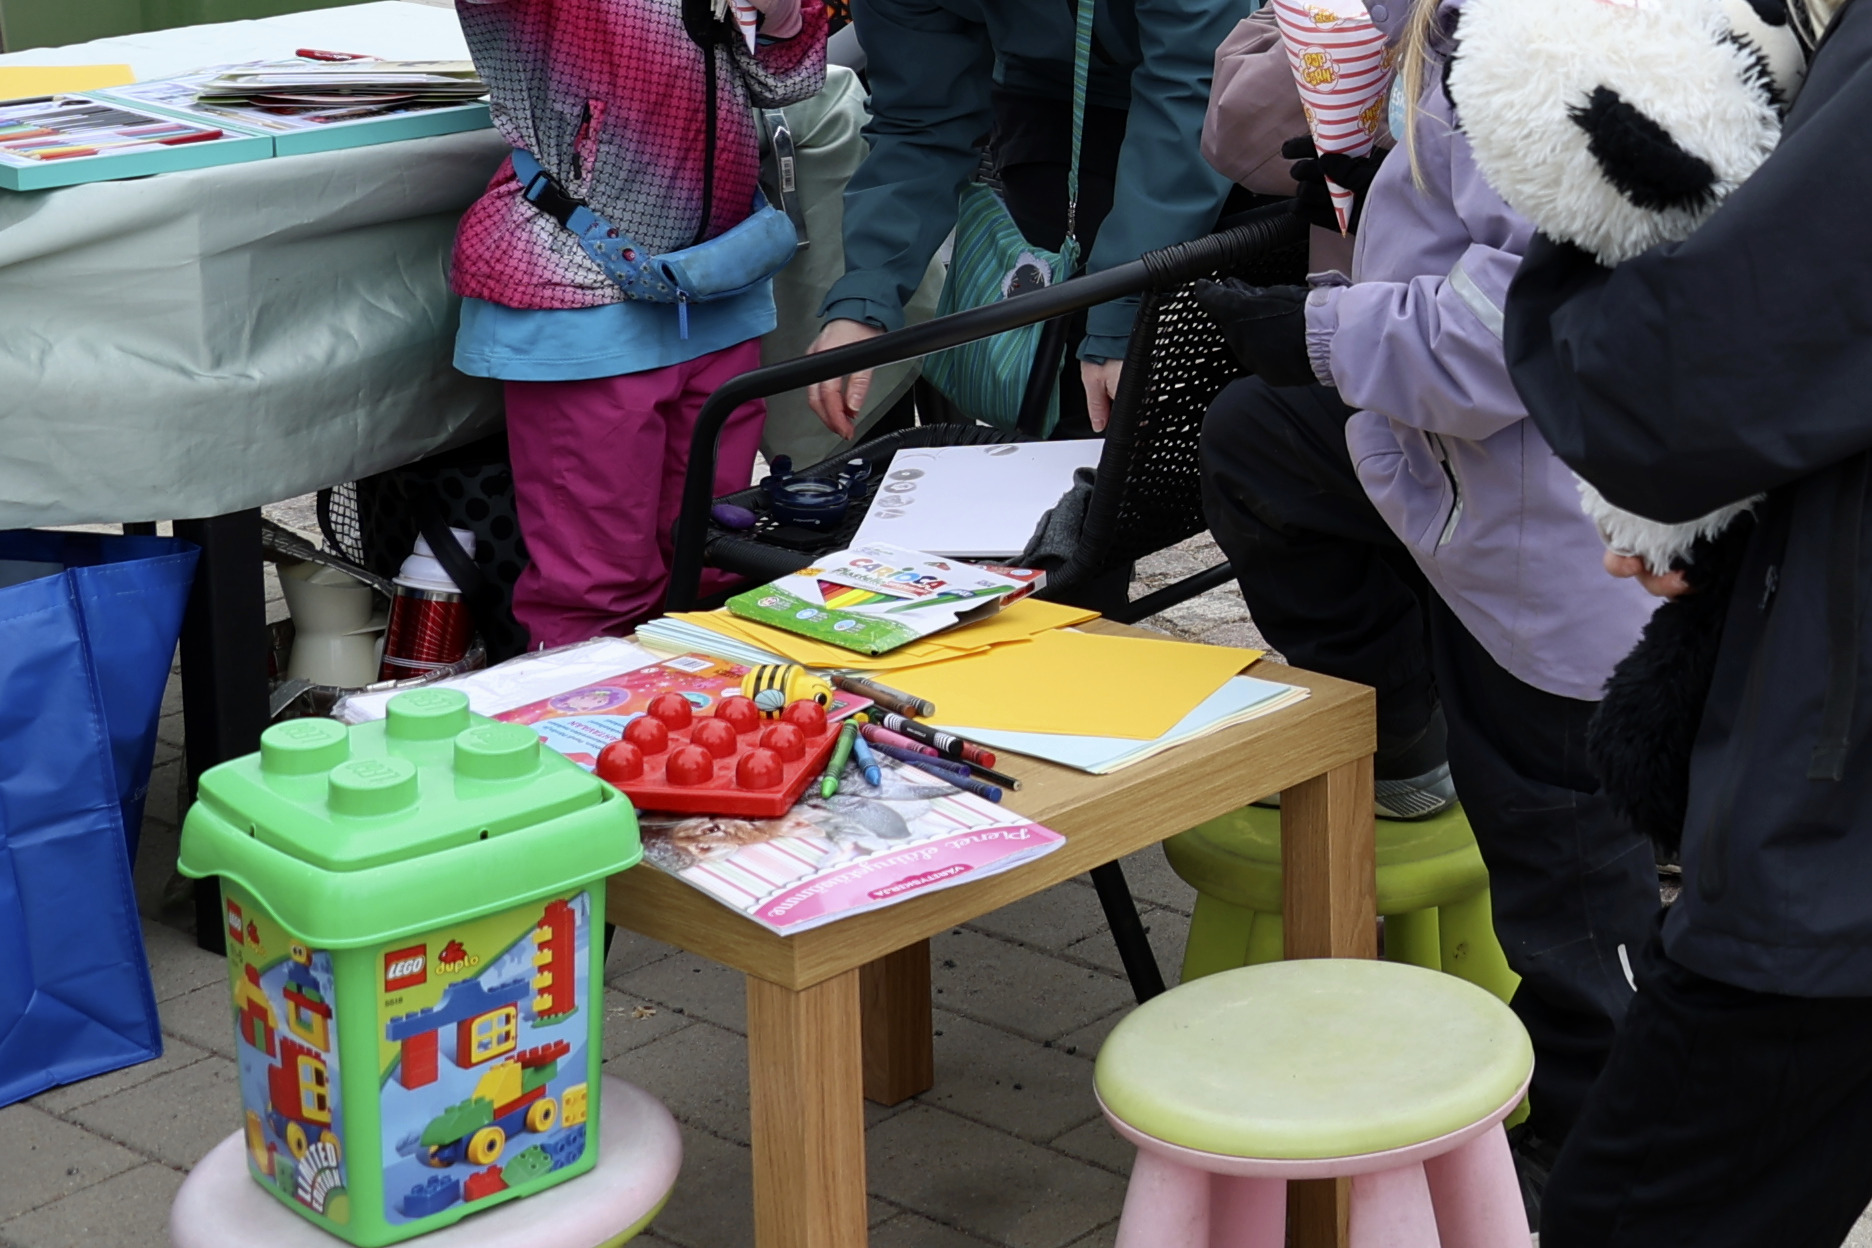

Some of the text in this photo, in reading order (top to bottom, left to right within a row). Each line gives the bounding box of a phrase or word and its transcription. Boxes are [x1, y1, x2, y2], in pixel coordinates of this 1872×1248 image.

[1304, 53, 1327, 67] POP
[944, 828, 1031, 851] Pienet
[387, 955, 479, 980] LEGO duplo
